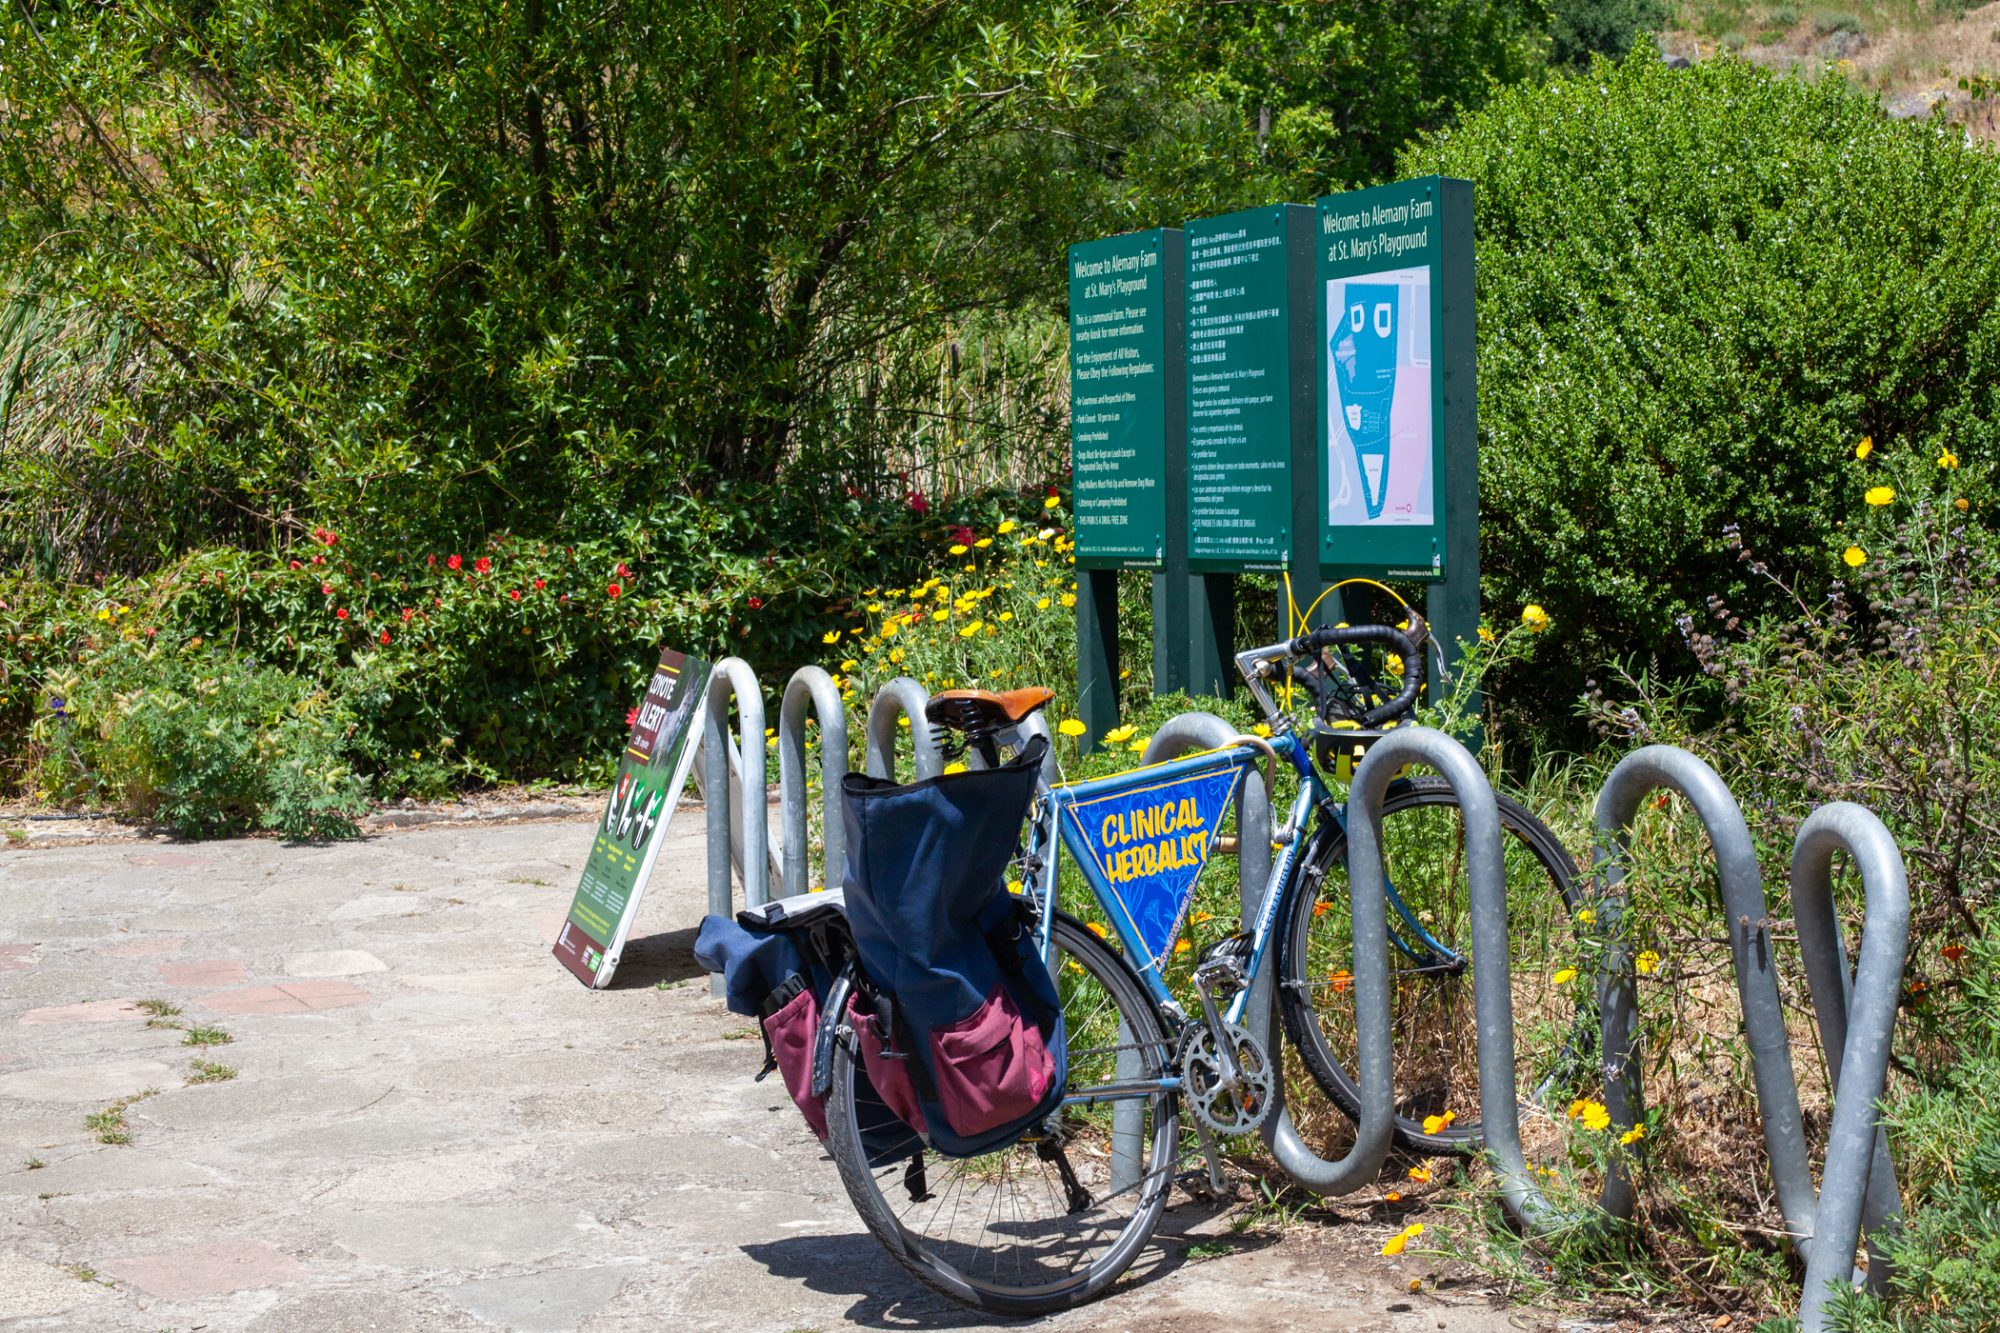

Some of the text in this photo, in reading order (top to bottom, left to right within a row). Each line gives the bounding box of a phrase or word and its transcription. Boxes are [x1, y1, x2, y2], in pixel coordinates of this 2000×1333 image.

[1323, 198, 1433, 235] Welcome to Alemany Farm
[1328, 226, 1427, 262] at St. Mary's Playground
[1075, 250, 1157, 278] Welcome to Alemany Farm
[1085, 286, 1090, 298] at
[1099, 281, 1116, 297] Mary's
[1117, 275, 1147, 295] Playground
[649, 672, 678, 702] COYOTE
[636, 701, 666, 733] ALERT
[1102, 797, 1205, 848] CLINICAL
[1105, 830, 1210, 885] HERBALIST
